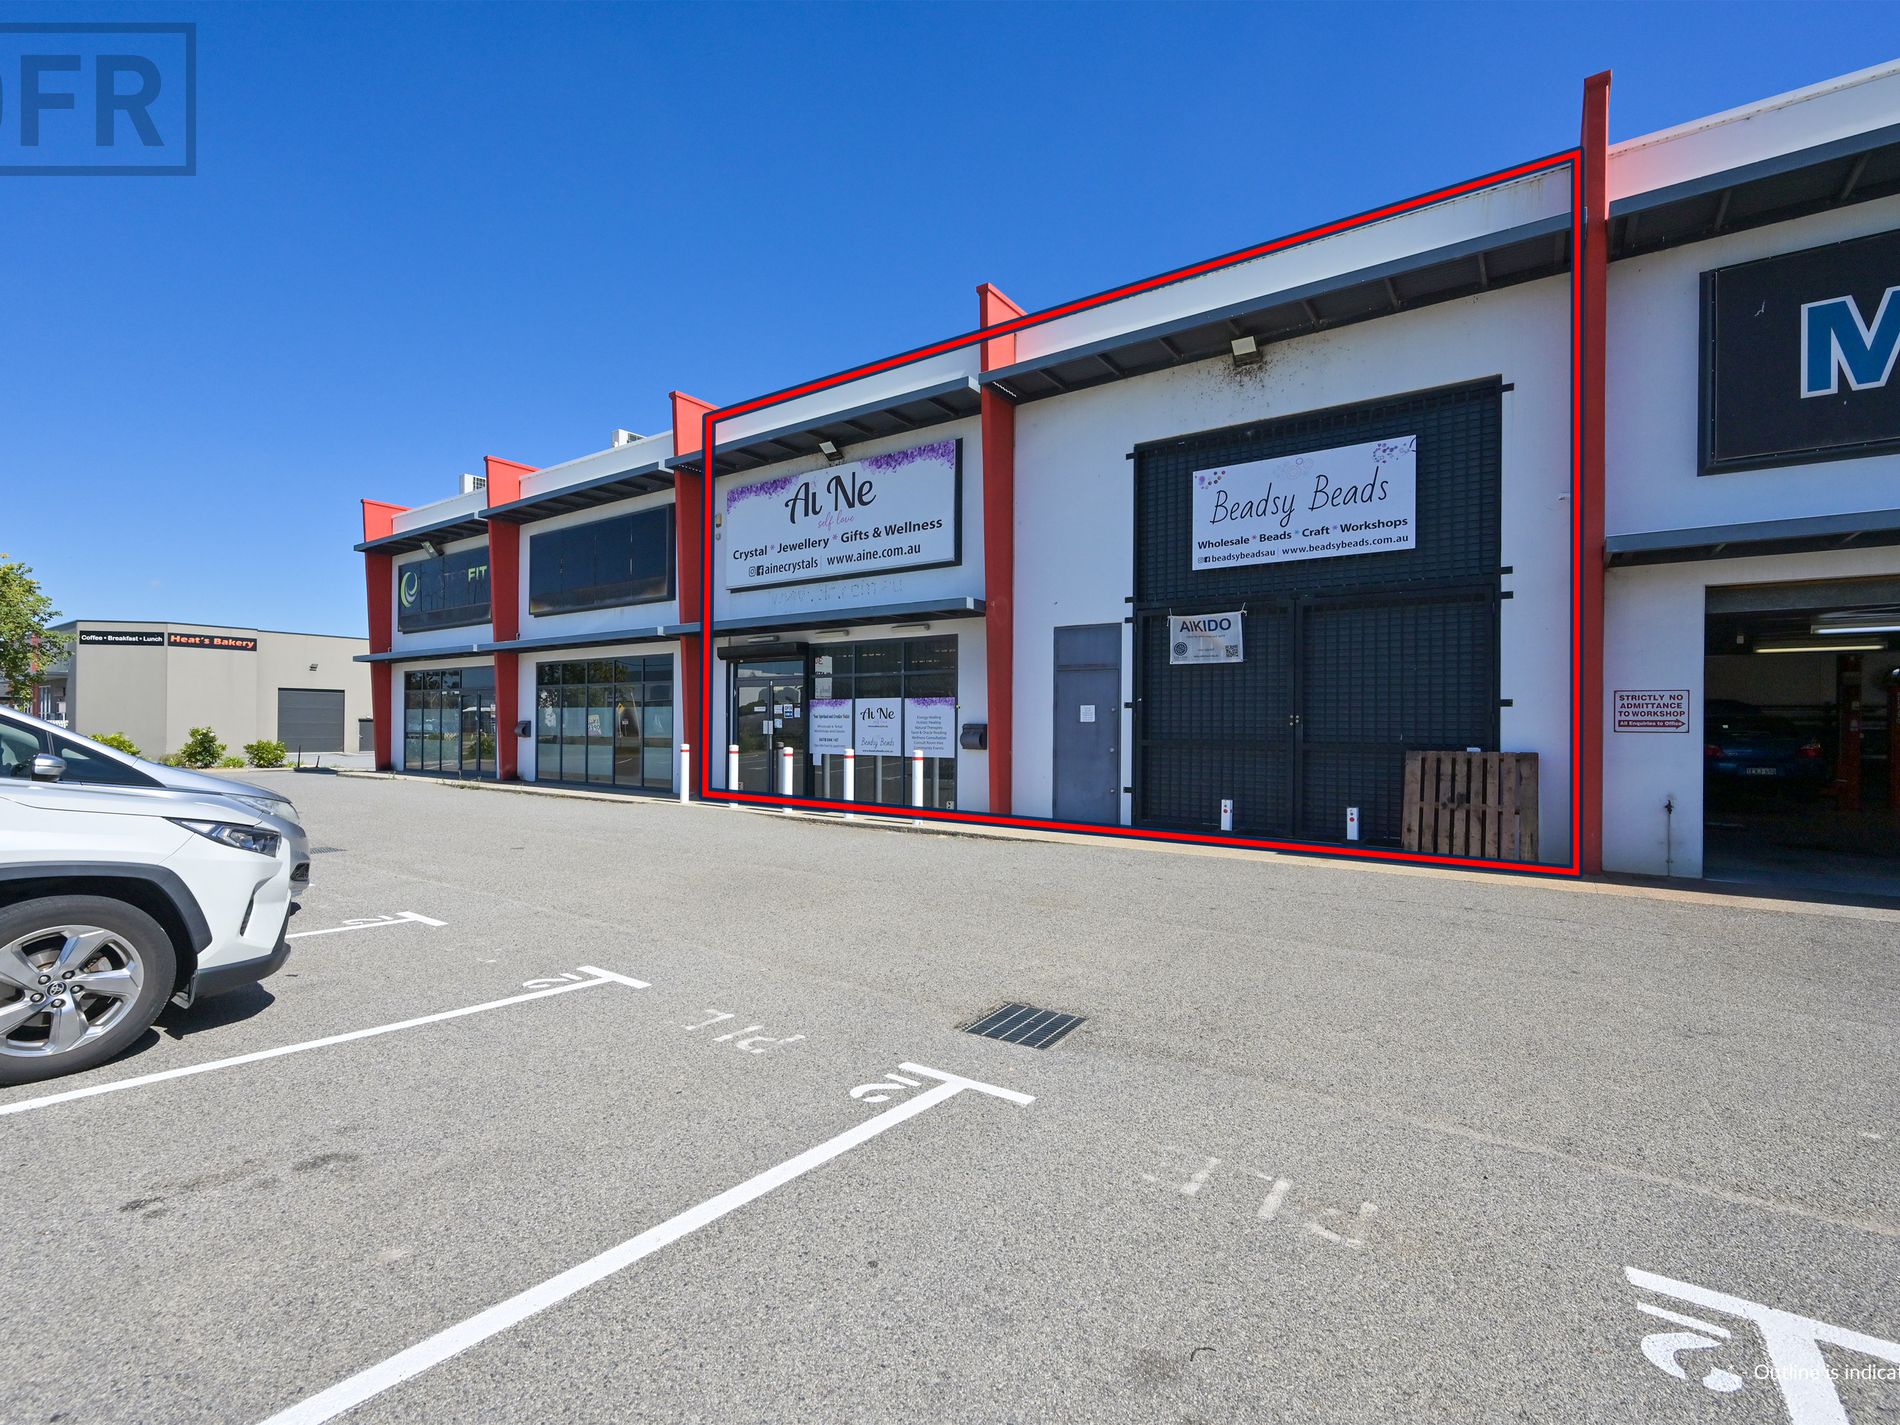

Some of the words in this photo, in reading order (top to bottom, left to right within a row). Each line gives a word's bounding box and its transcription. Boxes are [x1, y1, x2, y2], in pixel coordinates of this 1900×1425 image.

[826, 471, 877, 512] Ne
[1209, 482, 1296, 528] Beadsy
[1308, 465, 1390, 512] Beads
[817, 512, 833, 531] self
[836, 509, 855, 524] love
[732, 545, 768, 561] Crystal
[776, 537, 830, 554] Jewellery
[840, 529, 869, 543] Gifts
[872, 526, 882, 539] &
[884, 518, 943, 536] Wellness
[1197, 535, 1250, 550] Wholesale
[1259, 530, 1292, 542] Beads
[1302, 525, 1330, 538] Craft
[1339, 518, 1409, 533] Workshops
[764, 556, 819, 575] ainecrystals
[826, 543, 921, 566] www.aine.com.au
[1211, 549, 1276, 563] beadsybeadsau
[1281, 534, 1409, 555] www.beadsybeads.com.au
[468, 565, 487, 582] FIT
[1179, 618, 1231, 632] AIKIDO
[170, 635, 210, 645] Heat's
[213, 637, 255, 649] Bakery
[1619, 694, 1665, 702] STRICTLY
[876, 707, 896, 720] Ne
